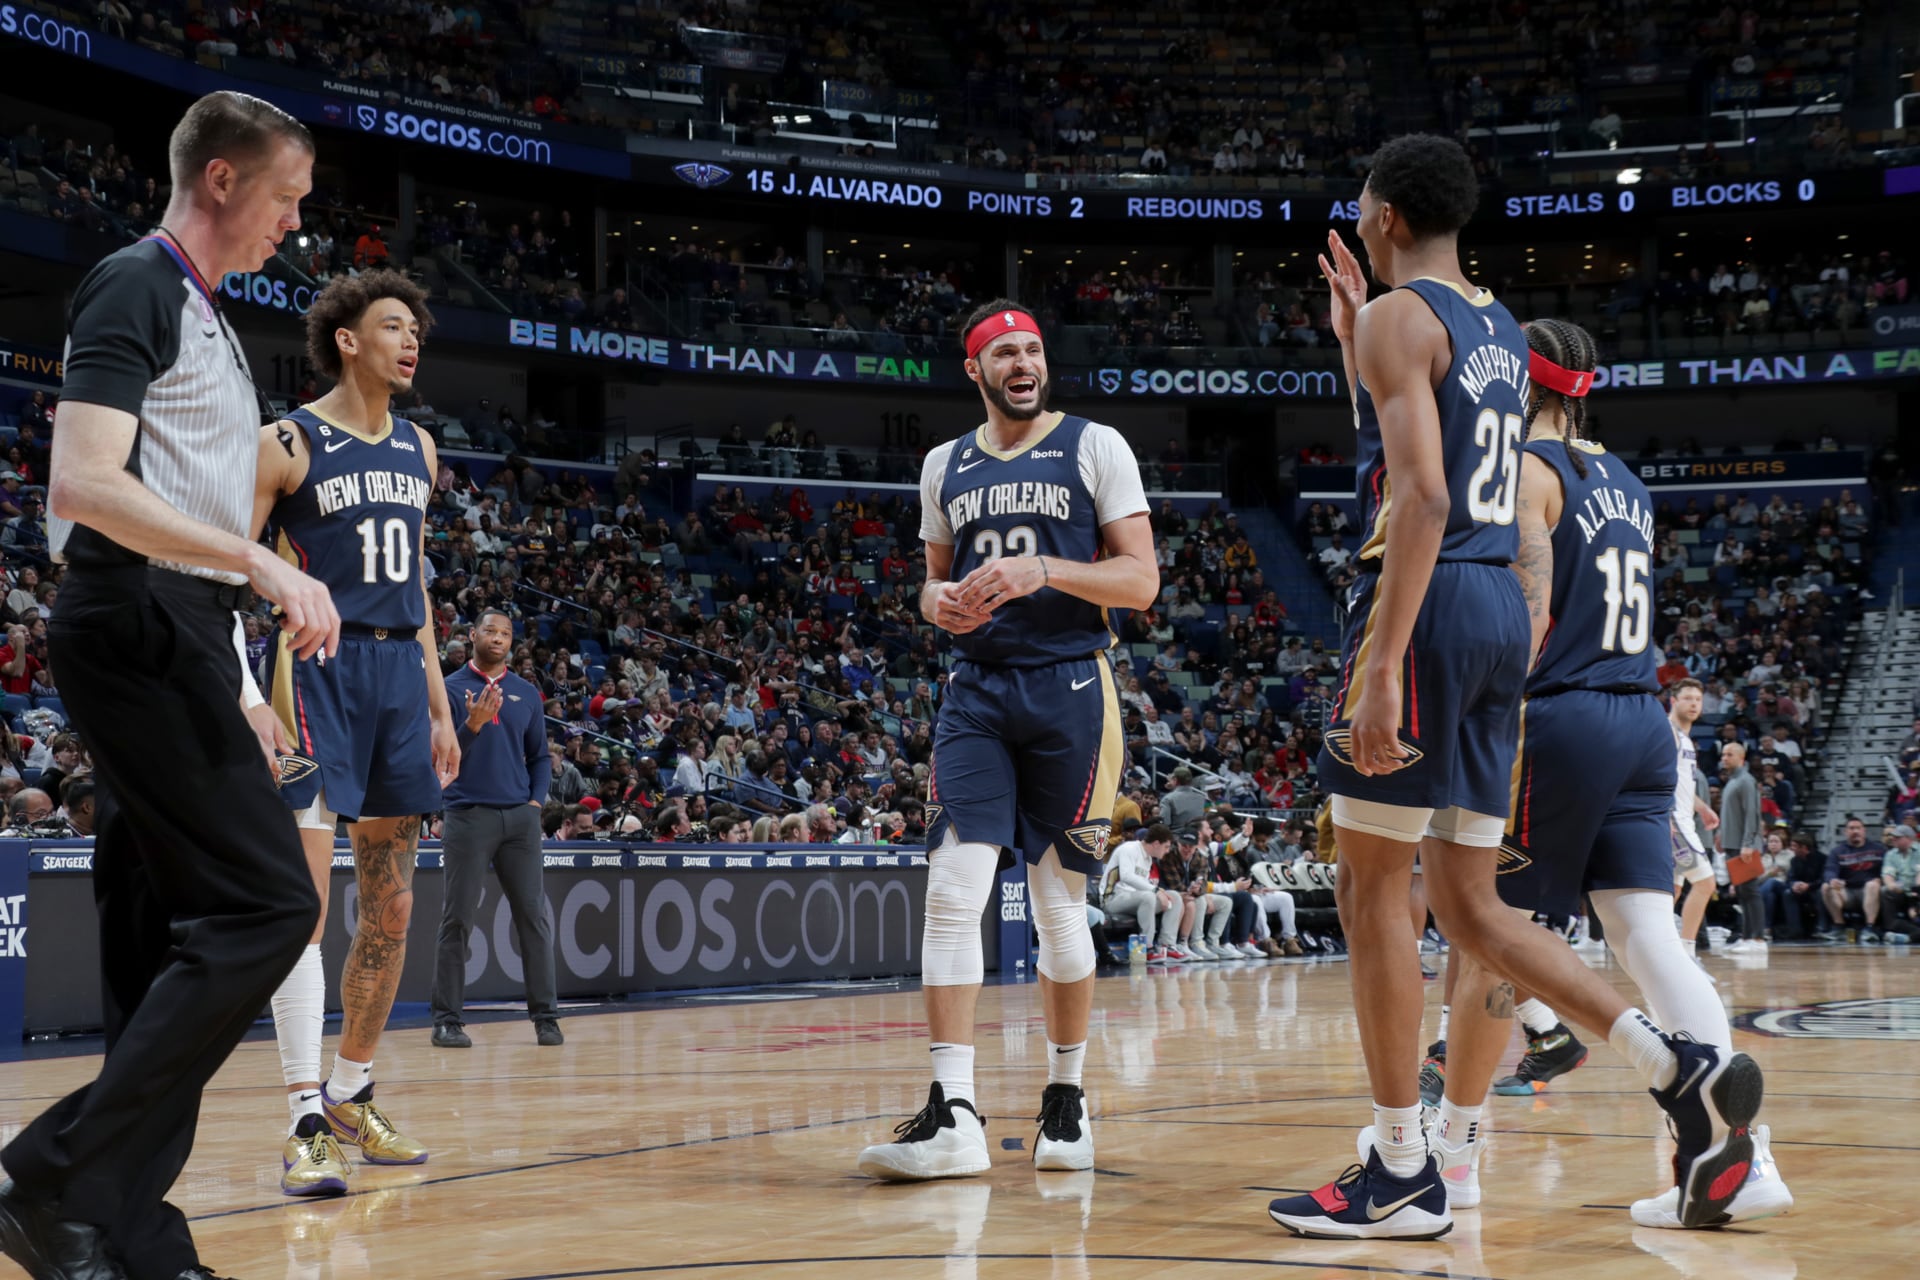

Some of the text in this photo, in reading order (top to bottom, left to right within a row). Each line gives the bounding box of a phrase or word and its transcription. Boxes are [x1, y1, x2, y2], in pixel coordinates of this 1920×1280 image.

[323, 80, 380, 98] PLAYERS PASS
[404, 96, 542, 131] PLAYER-FUNDED COMMUNITY TICKETS
[383, 111, 551, 164] SOCIOS.com
[864, 162, 910, 175] COMMUNITY
[910, 167, 941, 178] TICKETS
[747, 169, 774, 193] 15
[782, 173, 803, 195] J.
[809, 176, 942, 208] ALVARADO
[968, 191, 1052, 216] POINTS
[1070, 197, 1084, 218] 2
[1127, 198, 1263, 219] REBOUNDS
[1279, 200, 1291, 221] 1
[1505, 192, 1604, 217] STEALS
[1618, 190, 1634, 213] 0
[1672, 180, 1781, 207] BLOCKS
[1798, 179, 1815, 201] 0
[509, 318, 930, 383] BE MORE THAN A FAN
[1458, 344, 1521, 404] MURPHY
[1679, 355, 1806, 385] THAN
[1824, 353, 1856, 377] A
[1130, 369, 1337, 396] SOCIOS.com
[319, 425, 332, 437] 6
[880, 411, 920, 448] 116
[390, 438, 416, 452] ibotta
[962, 448, 973, 460] 6
[1031, 450, 1064, 460] ibotta
[1468, 408, 1522, 526] 25
[1640, 460, 1786, 478] BETRIVERS
[314, 472, 361, 518] NEW
[947, 481, 1071, 535] NEW ORLEANS
[356, 518, 411, 583] 10
[1595, 547, 1650, 655] 15
[43, 855, 92, 870] SEATGEEK
[543, 855, 575, 867] SEATGEEK
[591, 855, 622, 867] SEATGEEK
[637, 855, 667, 867] SEATGEEK
[682, 855, 711, 868] SEATGEEK
[725, 856, 752, 868] SEATGEEK
[766, 856, 792, 868] SEATGEEK
[805, 855, 830, 867] SEATGEEK
[840, 855, 864, 867] SEATGEEK
[1002, 882, 1025, 902] SEAT
[1001, 902, 1027, 921] GEEK
